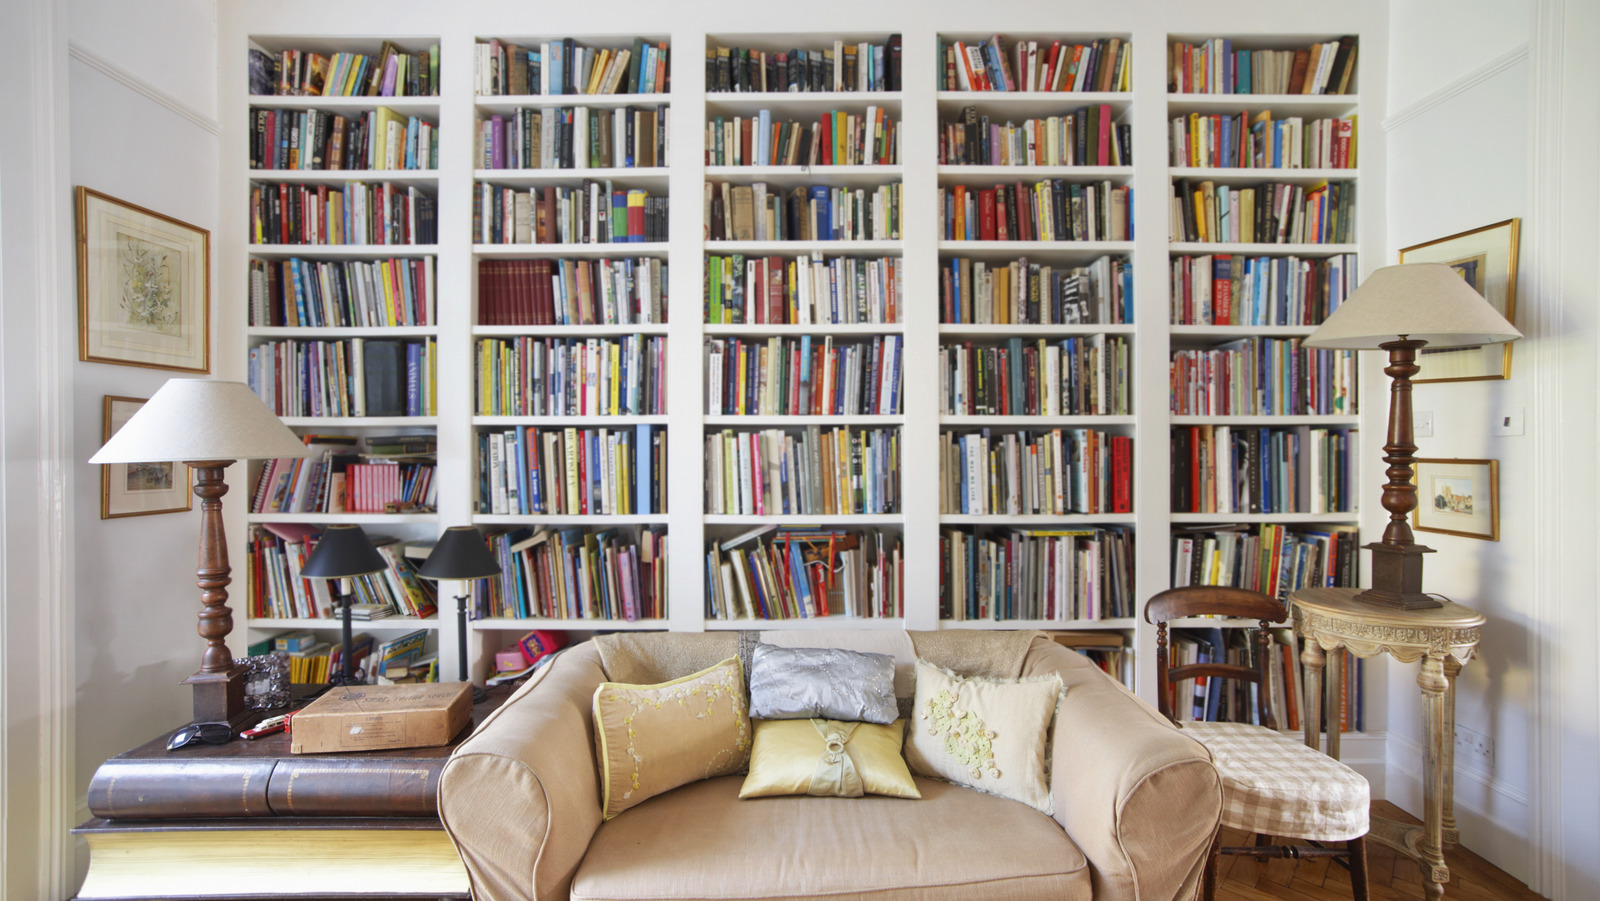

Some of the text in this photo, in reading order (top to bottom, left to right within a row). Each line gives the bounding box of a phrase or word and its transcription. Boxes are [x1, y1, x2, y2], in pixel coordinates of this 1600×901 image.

[733, 260, 741, 277] SPA
[565, 432, 575, 488] BEARDSLEY
[970, 476, 975, 485] WE
